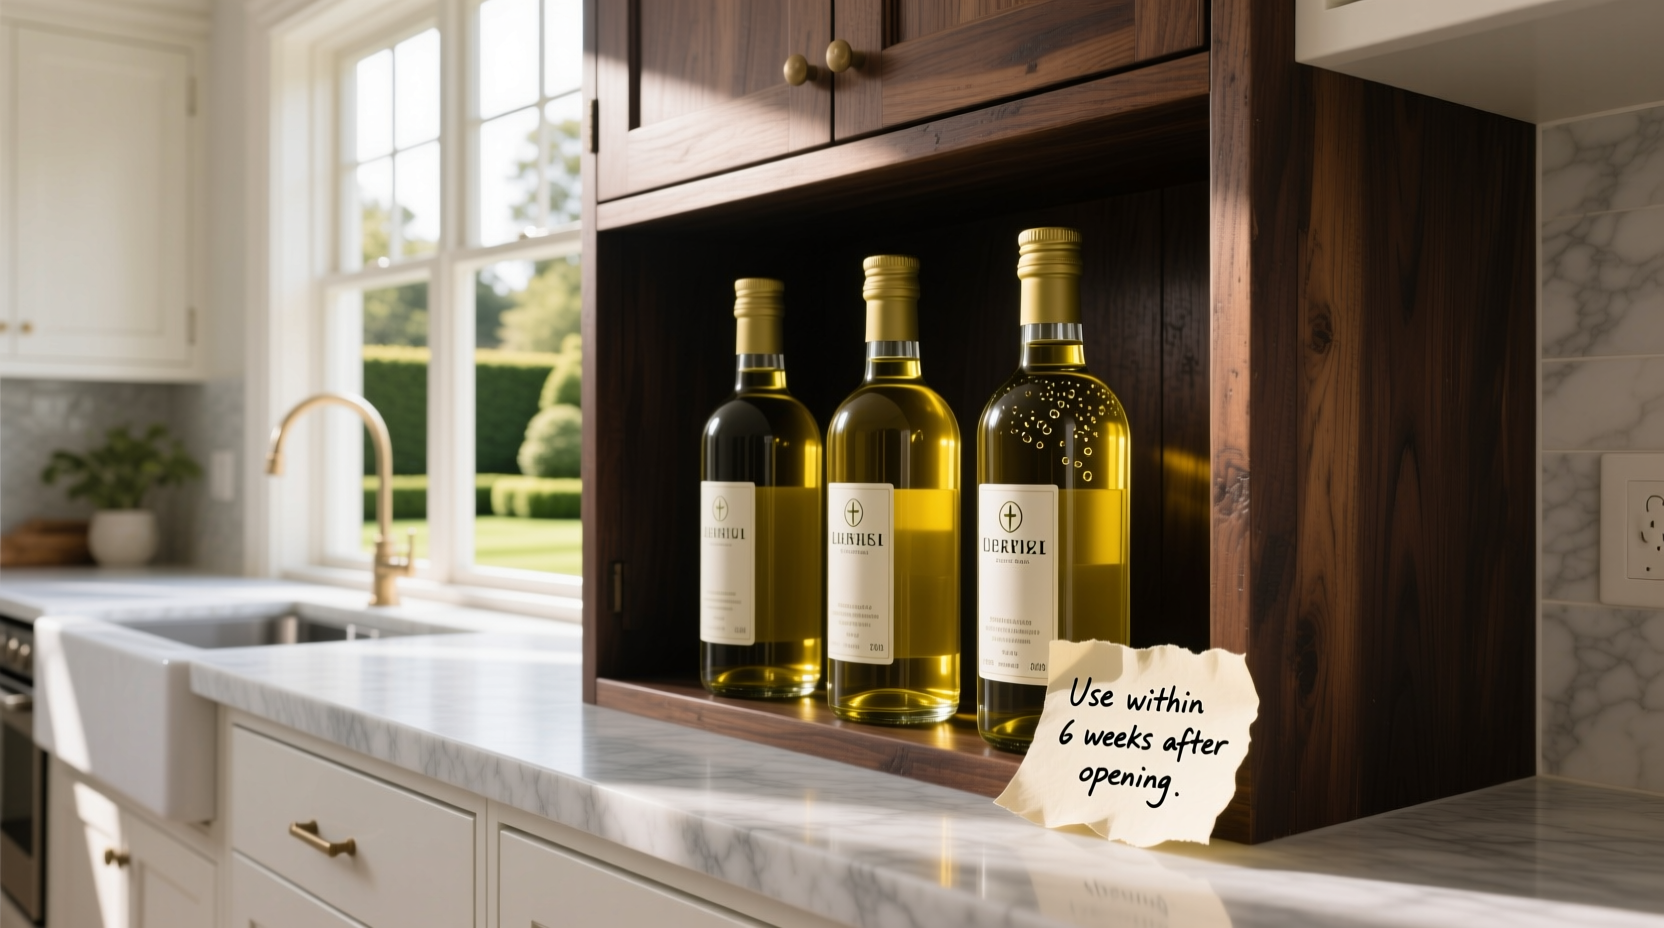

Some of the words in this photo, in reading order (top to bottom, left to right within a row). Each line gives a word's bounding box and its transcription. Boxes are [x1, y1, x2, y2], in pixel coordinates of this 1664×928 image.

[1069, 676, 1114, 708] Use
[1127, 686, 1204, 714] within
[1059, 719, 1075, 745] 6
[1084, 725, 1154, 751] weeks
[1162, 727, 1229, 763] after
[1079, 766, 1180, 809] opening.
